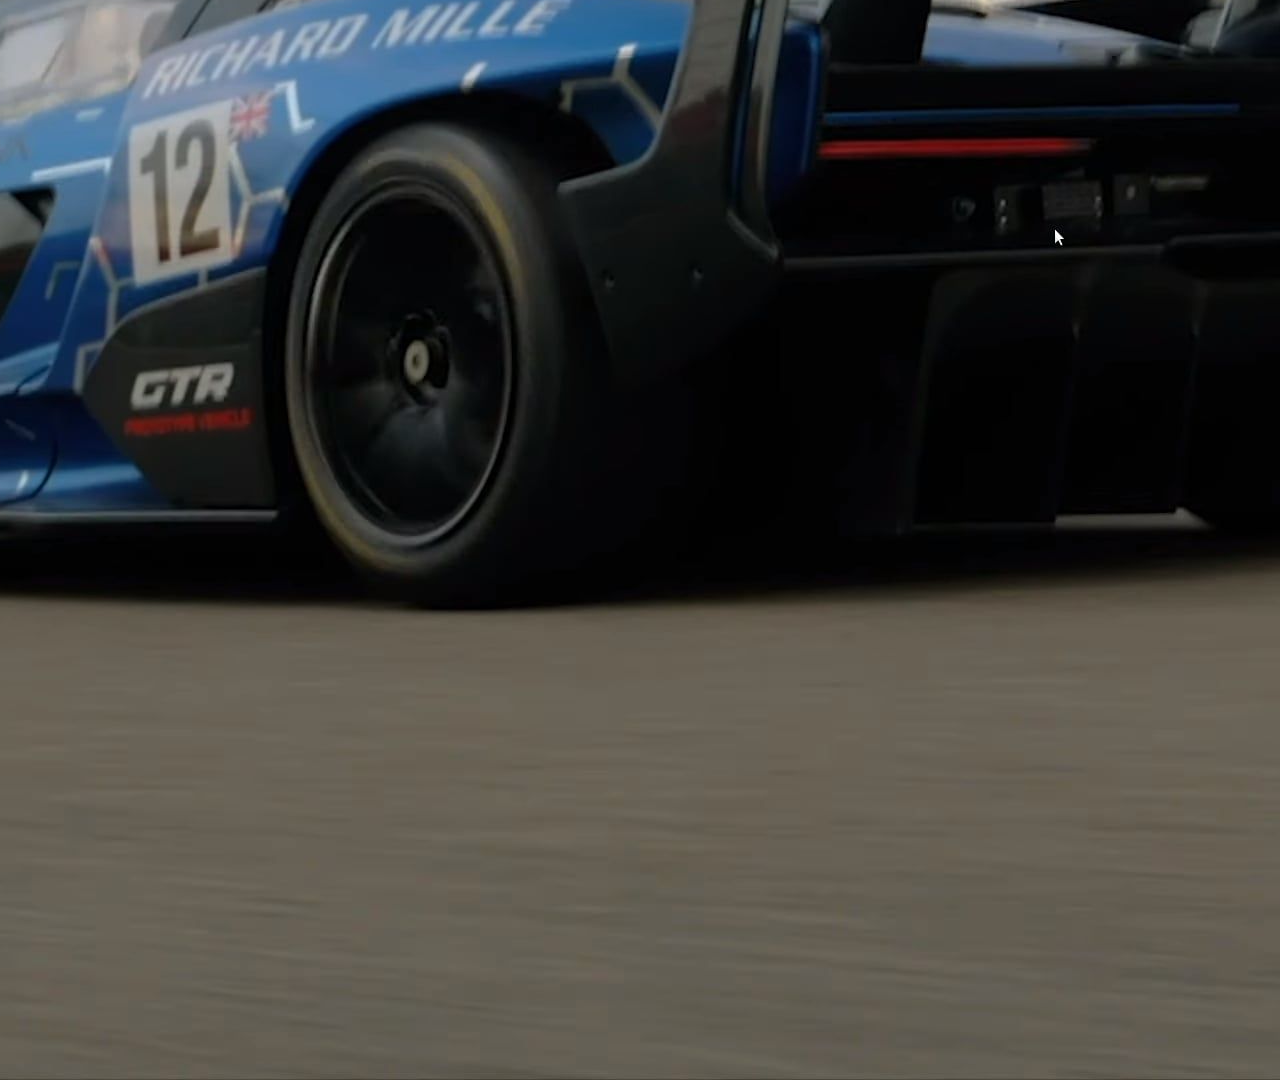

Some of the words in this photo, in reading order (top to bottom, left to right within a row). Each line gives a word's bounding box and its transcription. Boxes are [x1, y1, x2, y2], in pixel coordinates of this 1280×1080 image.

[142, 13, 370, 99] RICHARD
[140, 118, 221, 264] 12
[130, 362, 234, 410] GTR
